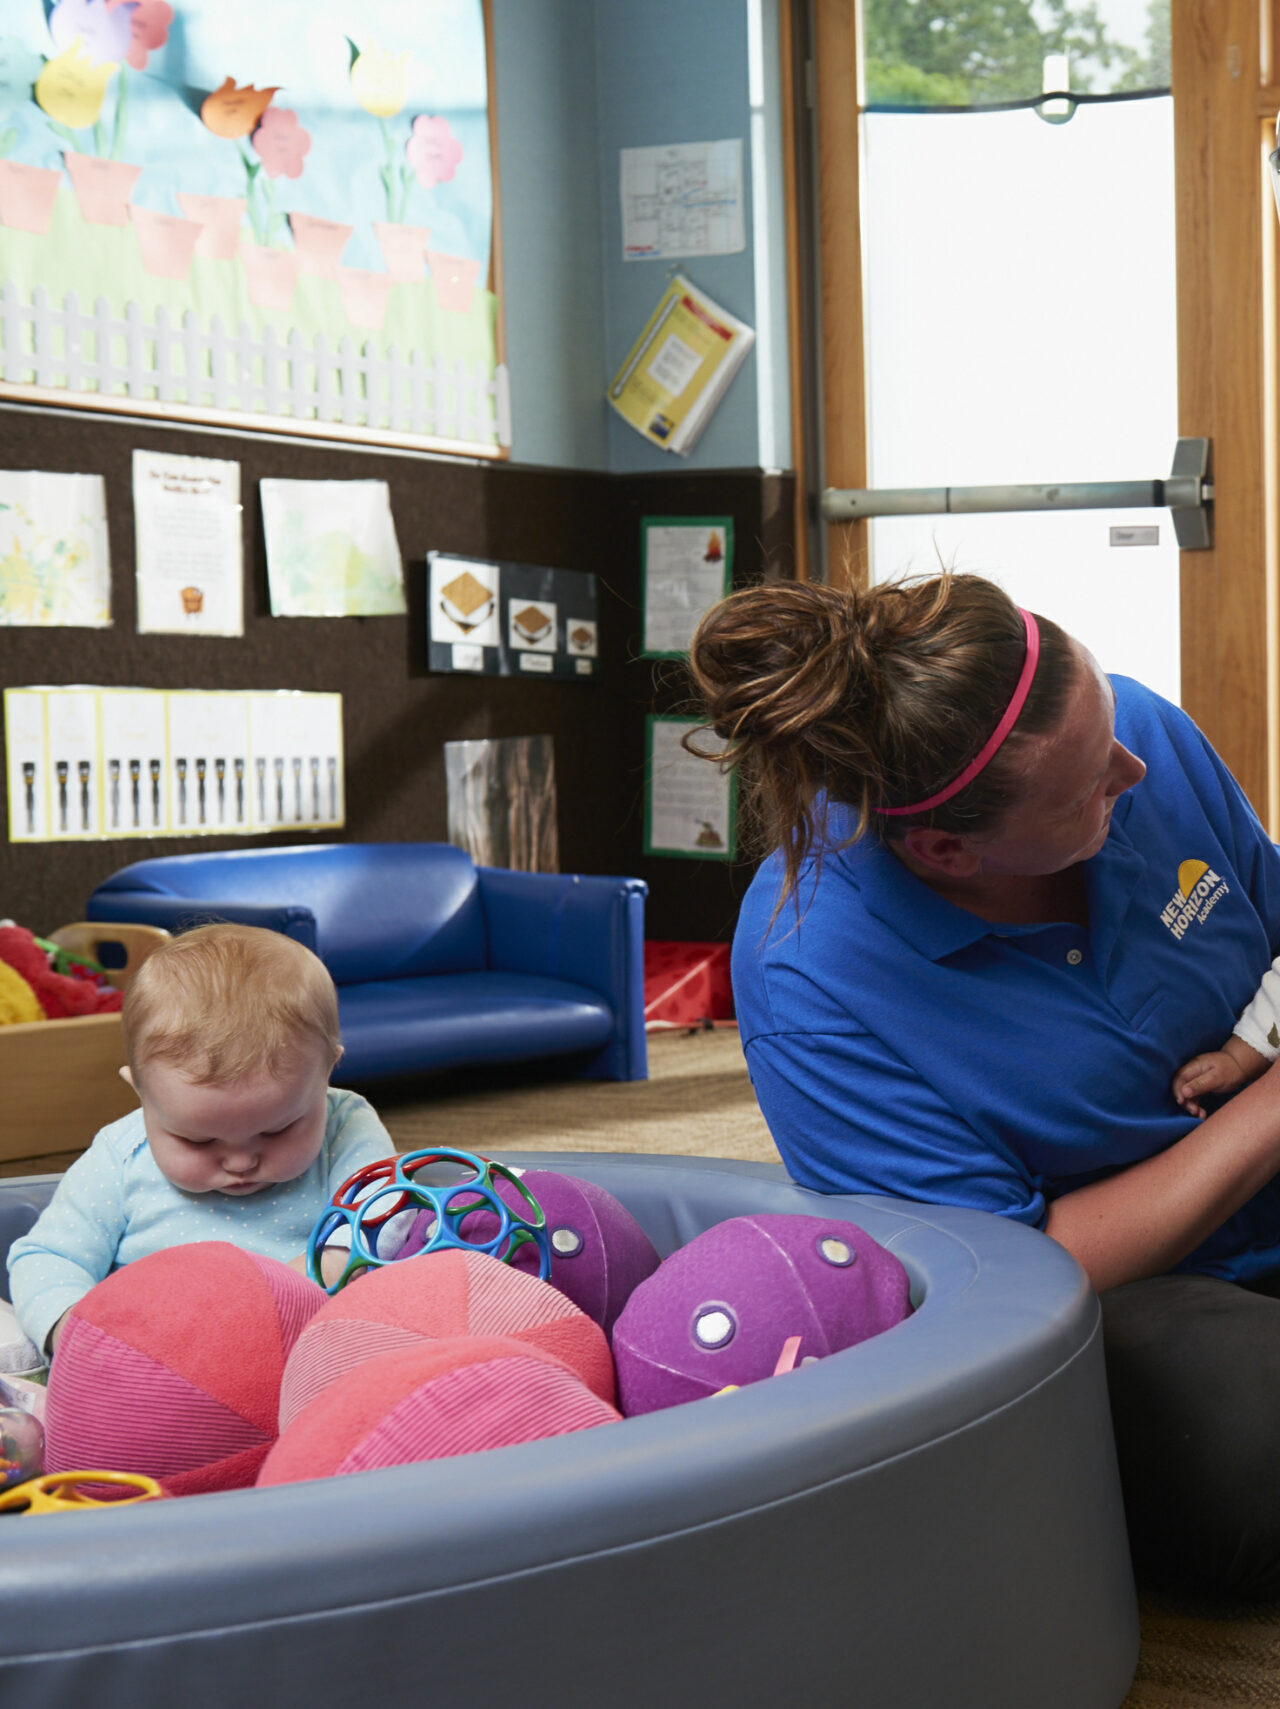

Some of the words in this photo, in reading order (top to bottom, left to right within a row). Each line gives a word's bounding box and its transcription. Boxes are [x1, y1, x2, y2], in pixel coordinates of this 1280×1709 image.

[1160, 888, 1187, 928] NEW
[1170, 869, 1221, 940] HORIZON
[1197, 881, 1230, 925] Academy
